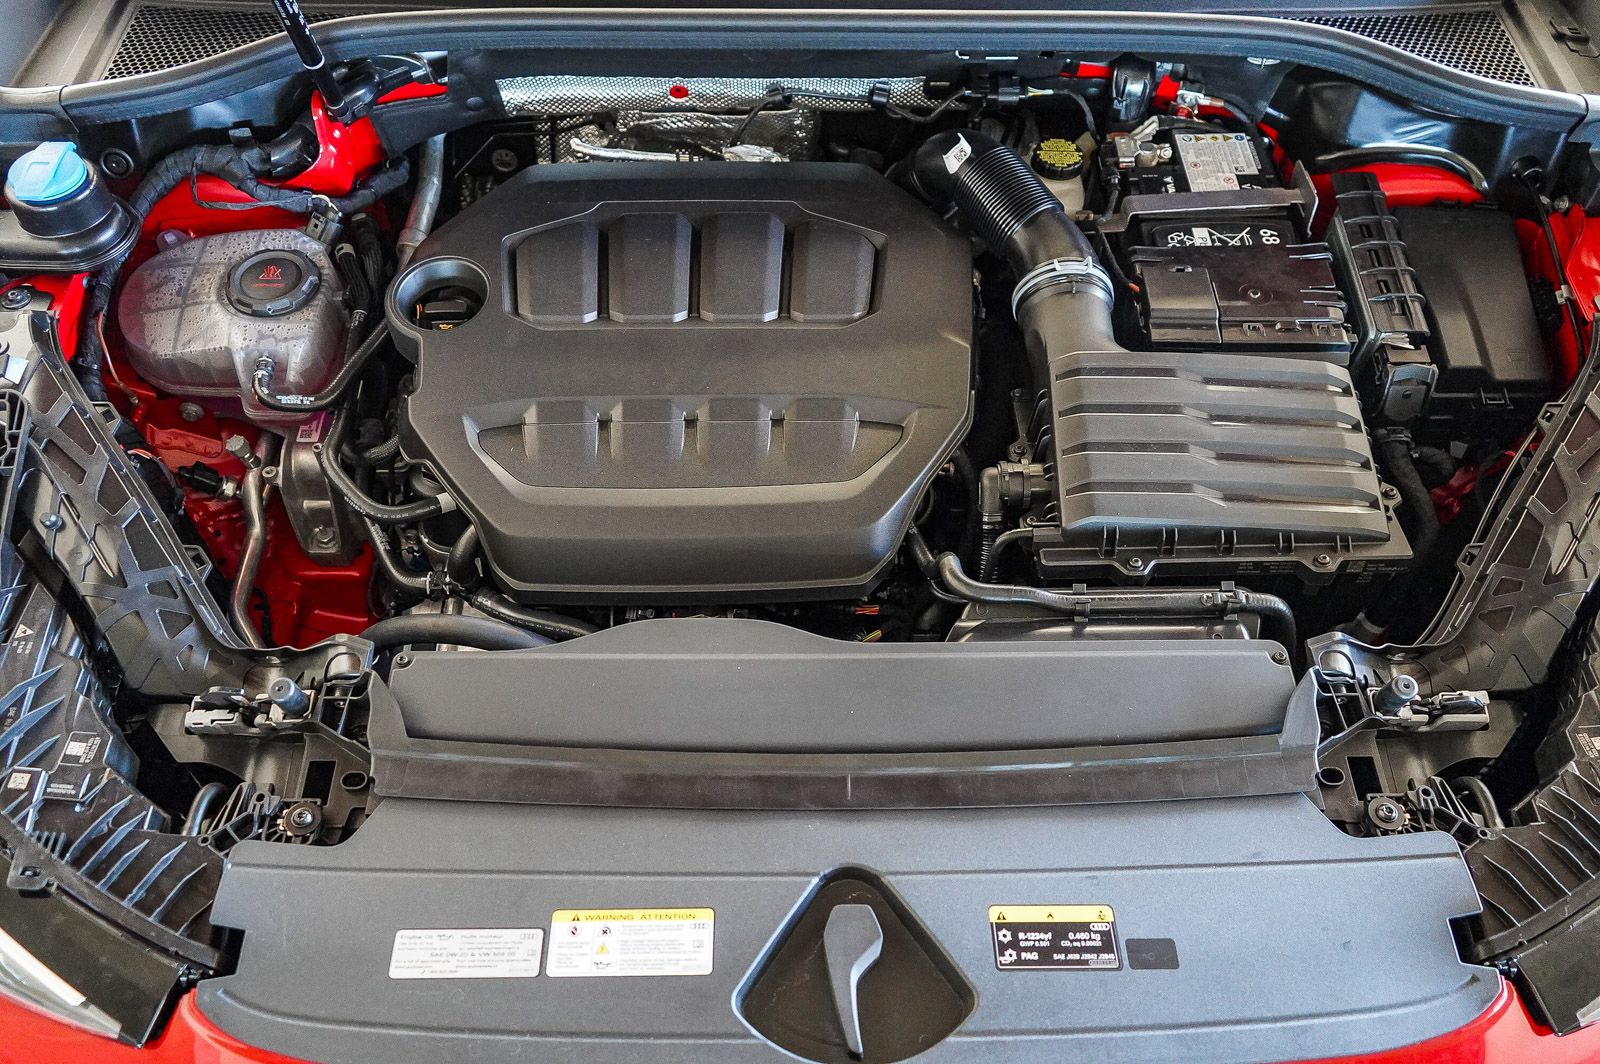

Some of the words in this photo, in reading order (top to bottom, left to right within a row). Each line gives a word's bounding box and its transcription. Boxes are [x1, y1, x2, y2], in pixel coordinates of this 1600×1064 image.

[1260, 228, 1281, 245] 68
[1091, 931, 1101, 941] kg
[1020, 952, 1039, 960] PAG
